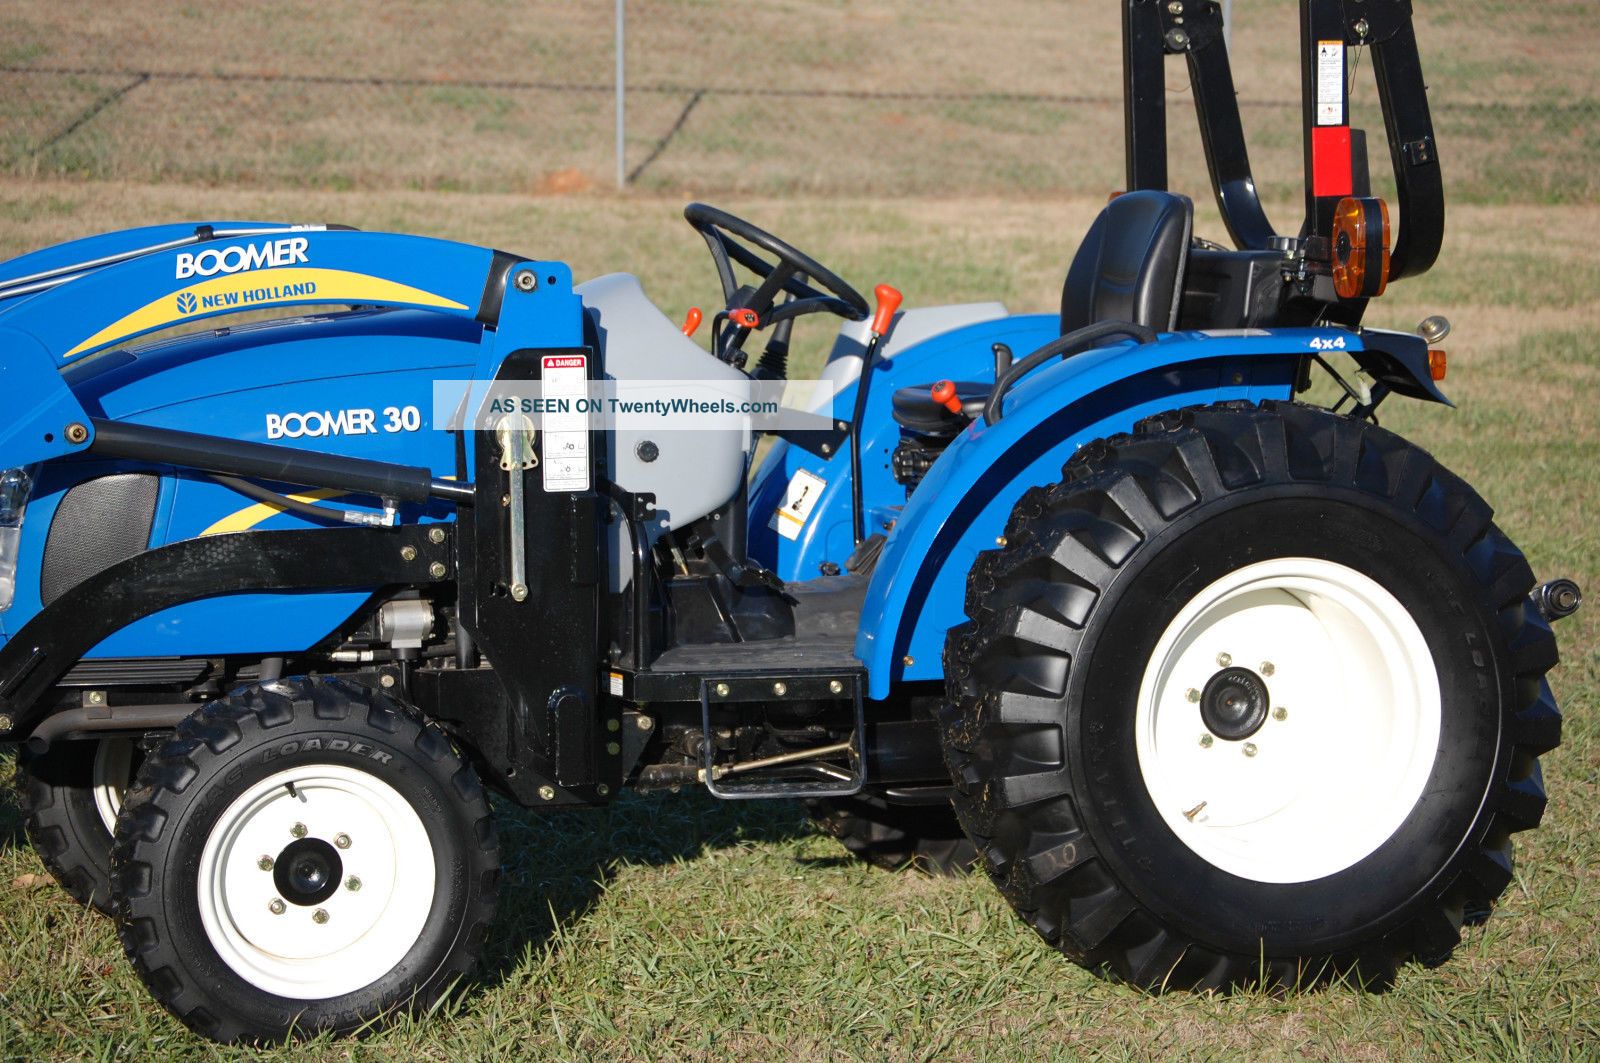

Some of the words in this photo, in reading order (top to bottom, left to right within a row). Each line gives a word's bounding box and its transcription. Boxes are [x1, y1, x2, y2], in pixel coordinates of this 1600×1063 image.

[175, 237, 309, 279] BOOMER
[202, 291, 238, 308] NEW
[243, 282, 316, 302] HOLLAND
[1309, 336, 1346, 350] 4x4
[555, 358, 582, 367] DANGER
[266, 408, 378, 439] BOOMER
[383, 405, 421, 433] 30
[260, 737, 394, 765] LOADER
